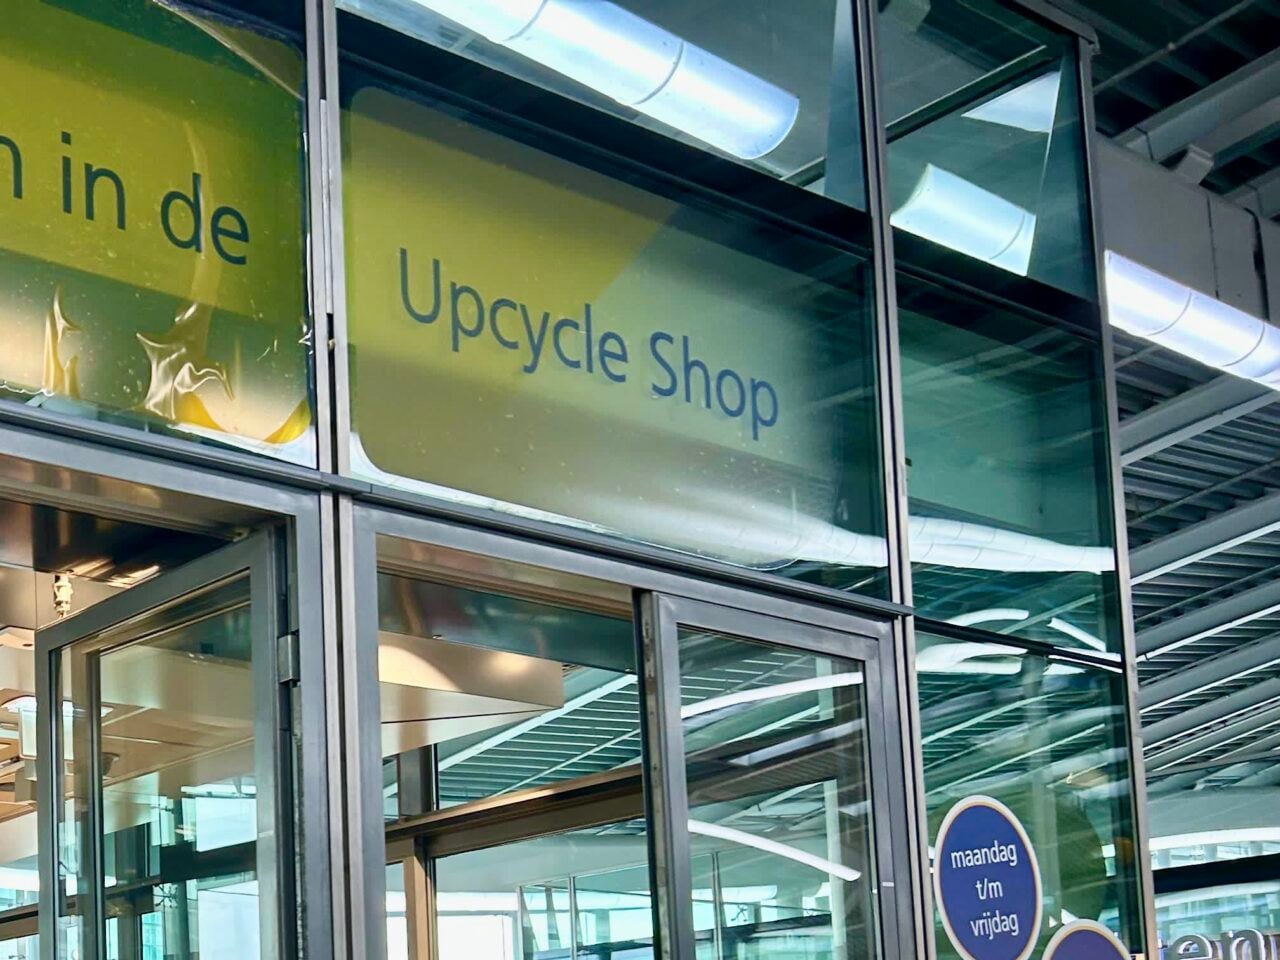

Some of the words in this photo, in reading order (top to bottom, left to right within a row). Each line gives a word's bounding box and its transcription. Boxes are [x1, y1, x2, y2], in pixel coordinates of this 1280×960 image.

[62, 131, 126, 231] in
[160, 172, 251, 266] de
[399, 247, 629, 383] Upcycle
[649, 331, 779, 440] Shop
[951, 840, 1018, 869] maandag
[975, 877, 1003, 900] t/m
[970, 911, 1019, 940] vrijdag
